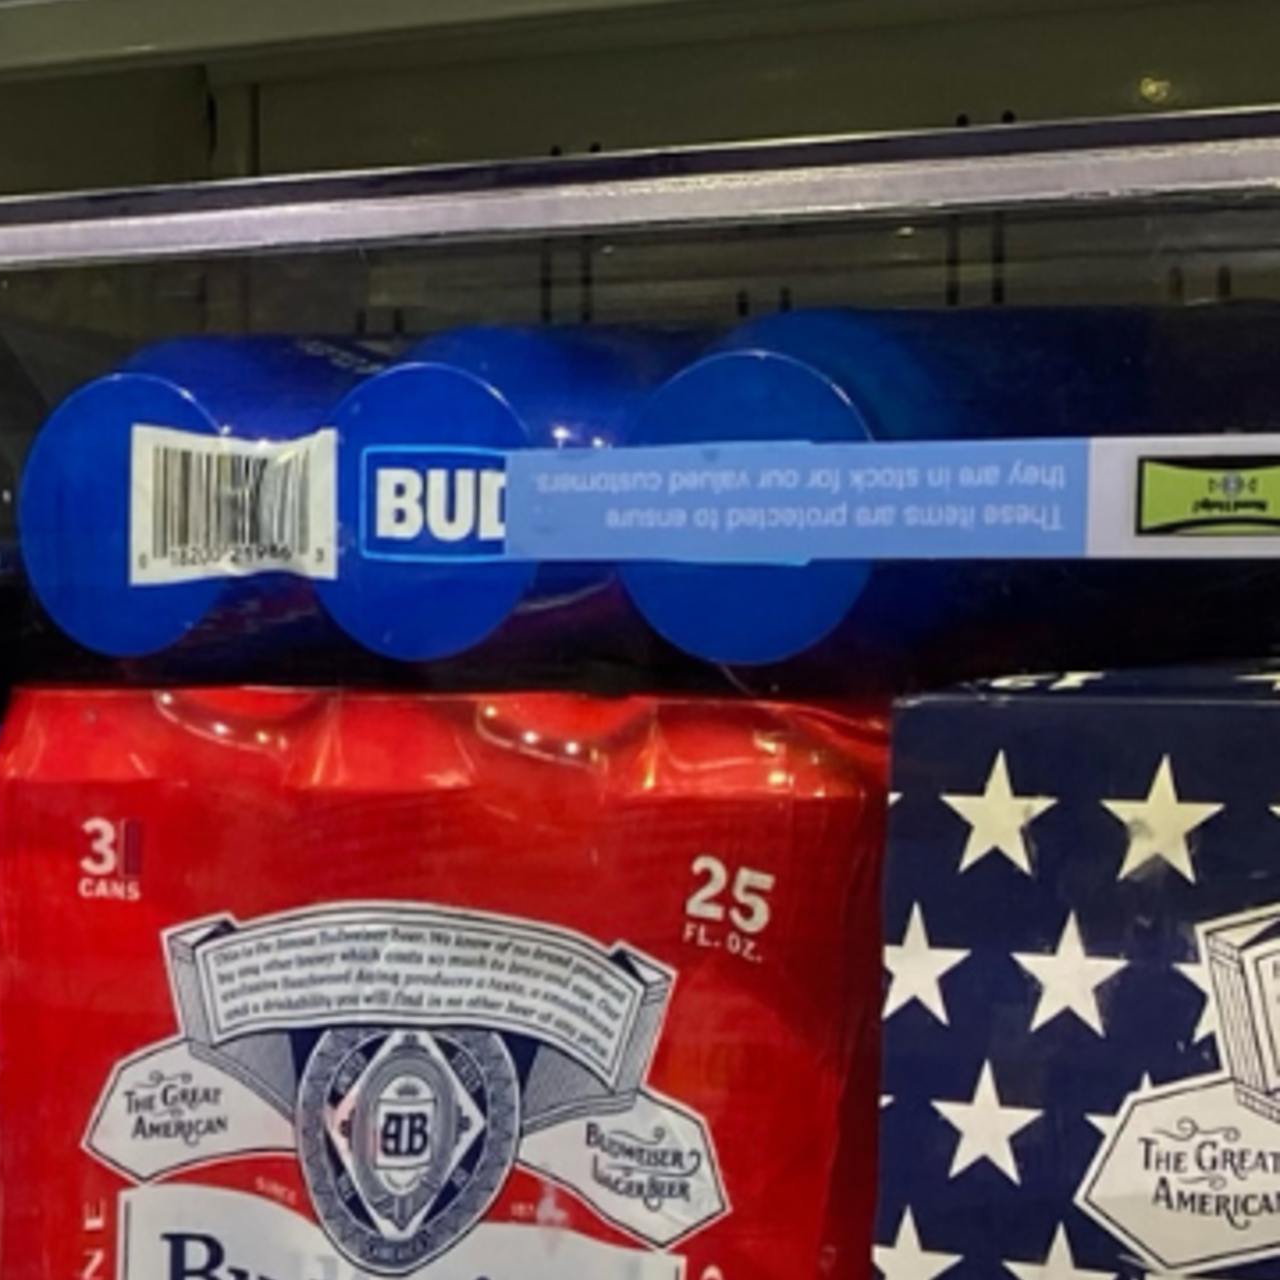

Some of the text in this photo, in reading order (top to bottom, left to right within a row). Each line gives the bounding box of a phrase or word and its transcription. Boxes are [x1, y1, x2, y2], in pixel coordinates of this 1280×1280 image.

[667, 458, 1068, 496] they are in stock for our valued
[604, 506, 688, 530] ensure
[727, 502, 848, 535] protected
[855, 503, 897, 527] are
[903, 502, 977, 532] items
[983, 502, 1065, 531] These
[78, 816, 118, 876] 3
[77, 876, 142, 901] CANS
[685, 854, 776, 934] 25
[123, 1083, 223, 1115] THE GREAT
[131, 1115, 229, 1148] AMERICAN
[1139, 1136, 1188, 1174] THE
